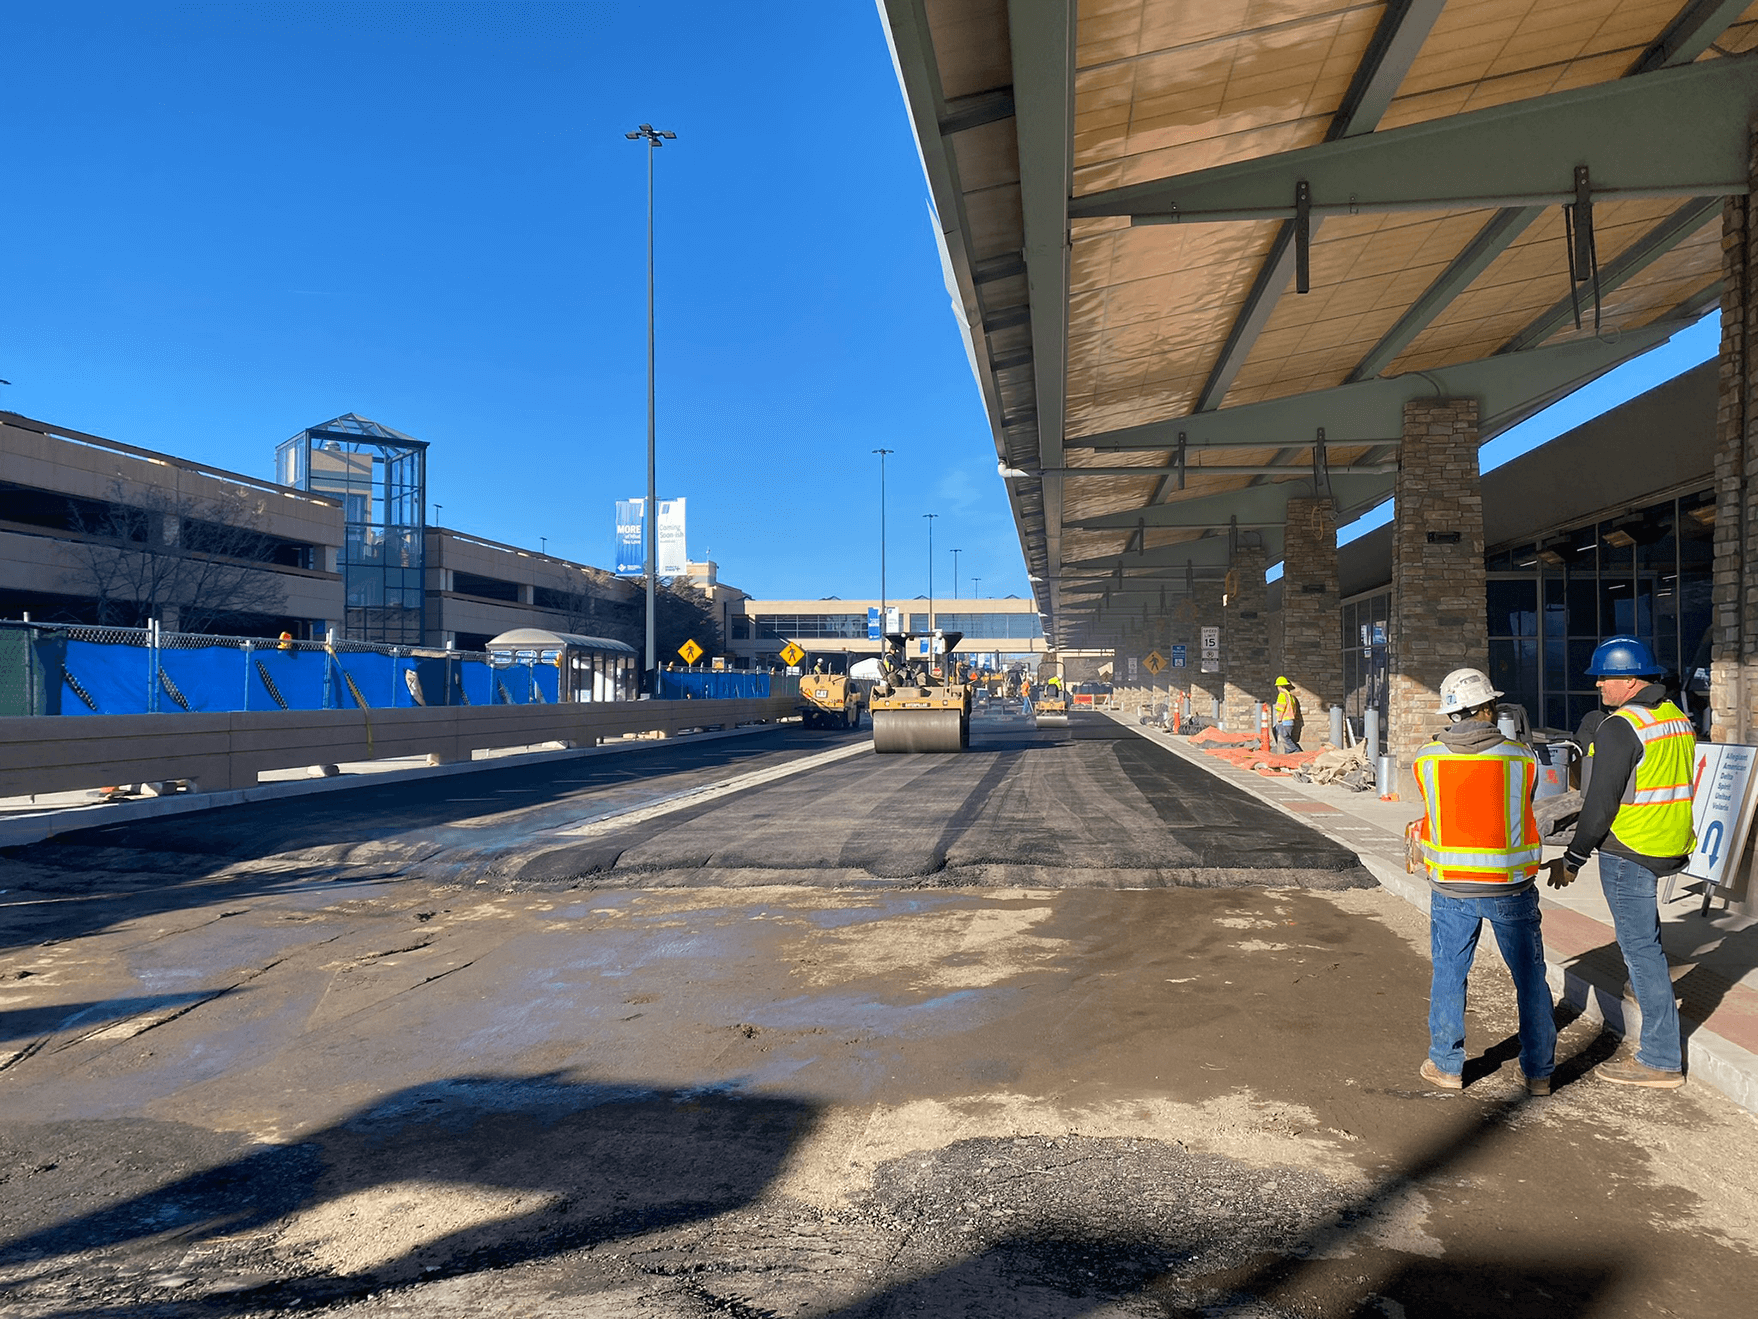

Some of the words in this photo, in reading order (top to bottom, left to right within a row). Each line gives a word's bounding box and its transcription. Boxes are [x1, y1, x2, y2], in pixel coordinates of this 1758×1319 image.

[617, 525, 641, 534] MORE
[1205, 638, 1216, 647] 15
[1725, 752, 1748, 762] Allegiant
[1723, 762, 1747, 771] American
[1720, 771, 1734, 780] Delta
[1718, 782, 1732, 790] Spirit
[1715, 791, 1732, 801] United
